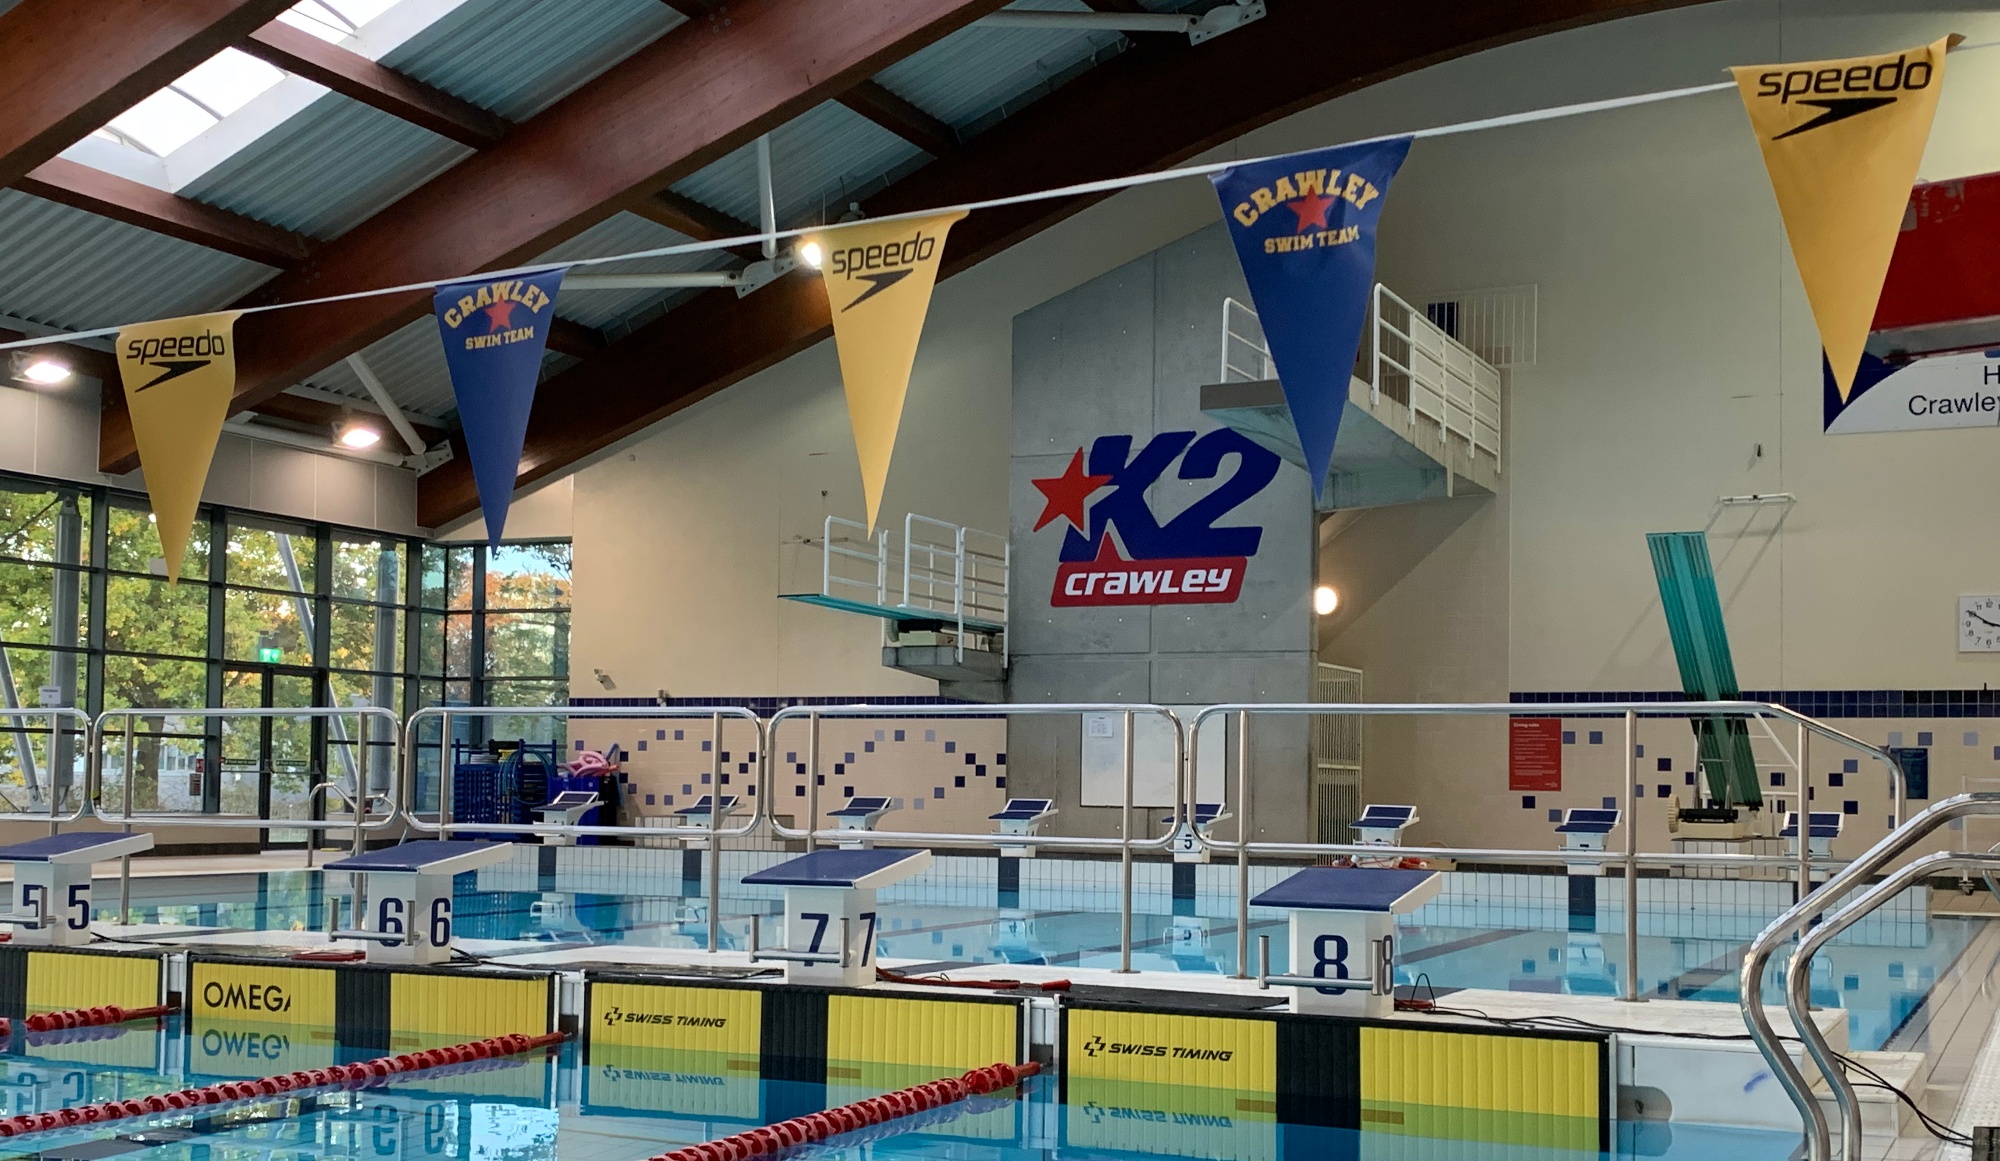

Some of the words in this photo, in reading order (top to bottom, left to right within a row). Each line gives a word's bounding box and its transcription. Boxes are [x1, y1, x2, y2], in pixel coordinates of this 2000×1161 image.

[1757, 54, 1933, 106] speedo
[1233, 168, 1379, 227] CRAWLEY
[831, 230, 936, 281] speedo
[1264, 233, 1314, 254] SWIM
[1316, 224, 1361, 247] TEAM
[444, 280, 550, 329] CRAWLEY
[126, 328, 225, 365] speedo
[465, 333, 501, 350] SWIM
[503, 325, 534, 344] TEAM
[1908, 391, 2000, 416] Crawle
[1059, 427, 1282, 563] K2
[1184, 834, 1193, 850] 5
[23, 884, 43, 930] 5
[68, 884, 90, 930] 5
[379, 897, 403, 947] 6
[430, 897, 451, 947] 6
[800, 912, 829, 967] 7
[859, 912, 876, 967] 7
[1313, 934, 1348, 995] 8
[1382, 934, 1394, 995] 8
[624, 1012, 674, 1025] SWISS
[677, 1015, 727, 1028] TIMING
[1108, 1043, 1168, 1057] SWISS
[1172, 1047, 1233, 1062] TIMING
